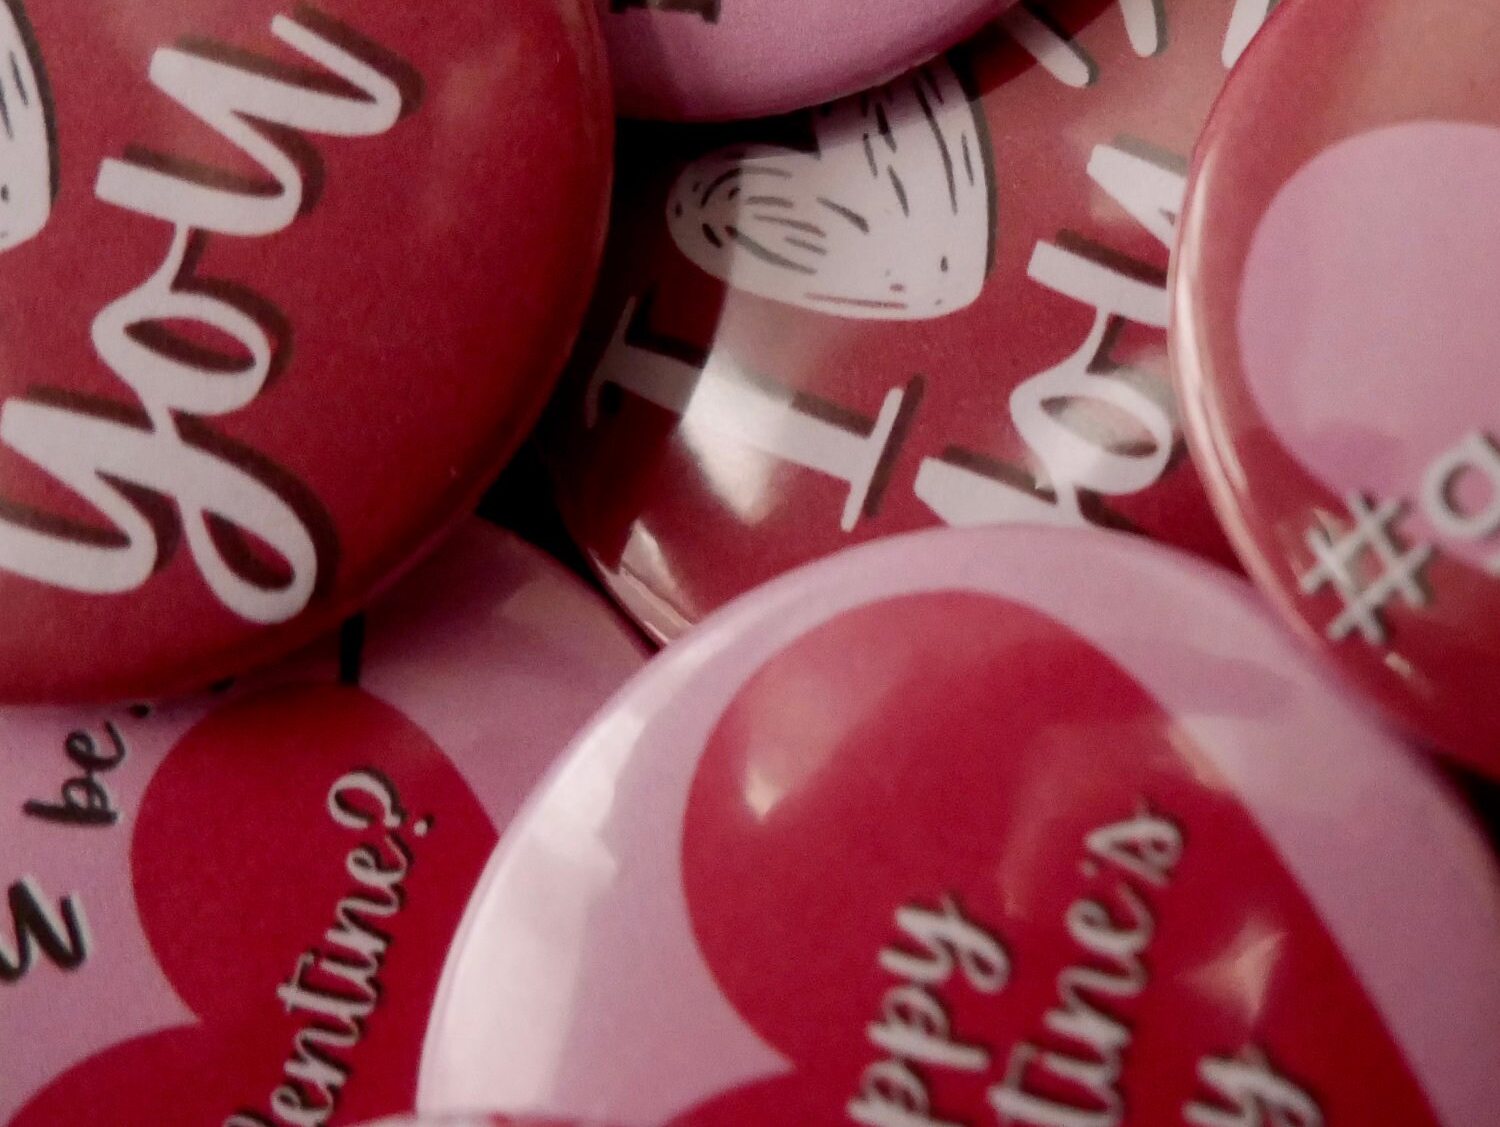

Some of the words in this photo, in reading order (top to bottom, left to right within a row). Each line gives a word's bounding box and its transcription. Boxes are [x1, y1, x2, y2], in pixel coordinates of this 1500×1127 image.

[0, 0, 424, 626] you
[586, 294, 922, 532] I
[23, 719, 127, 828] be
[225, 764, 436, 1127] entine?
